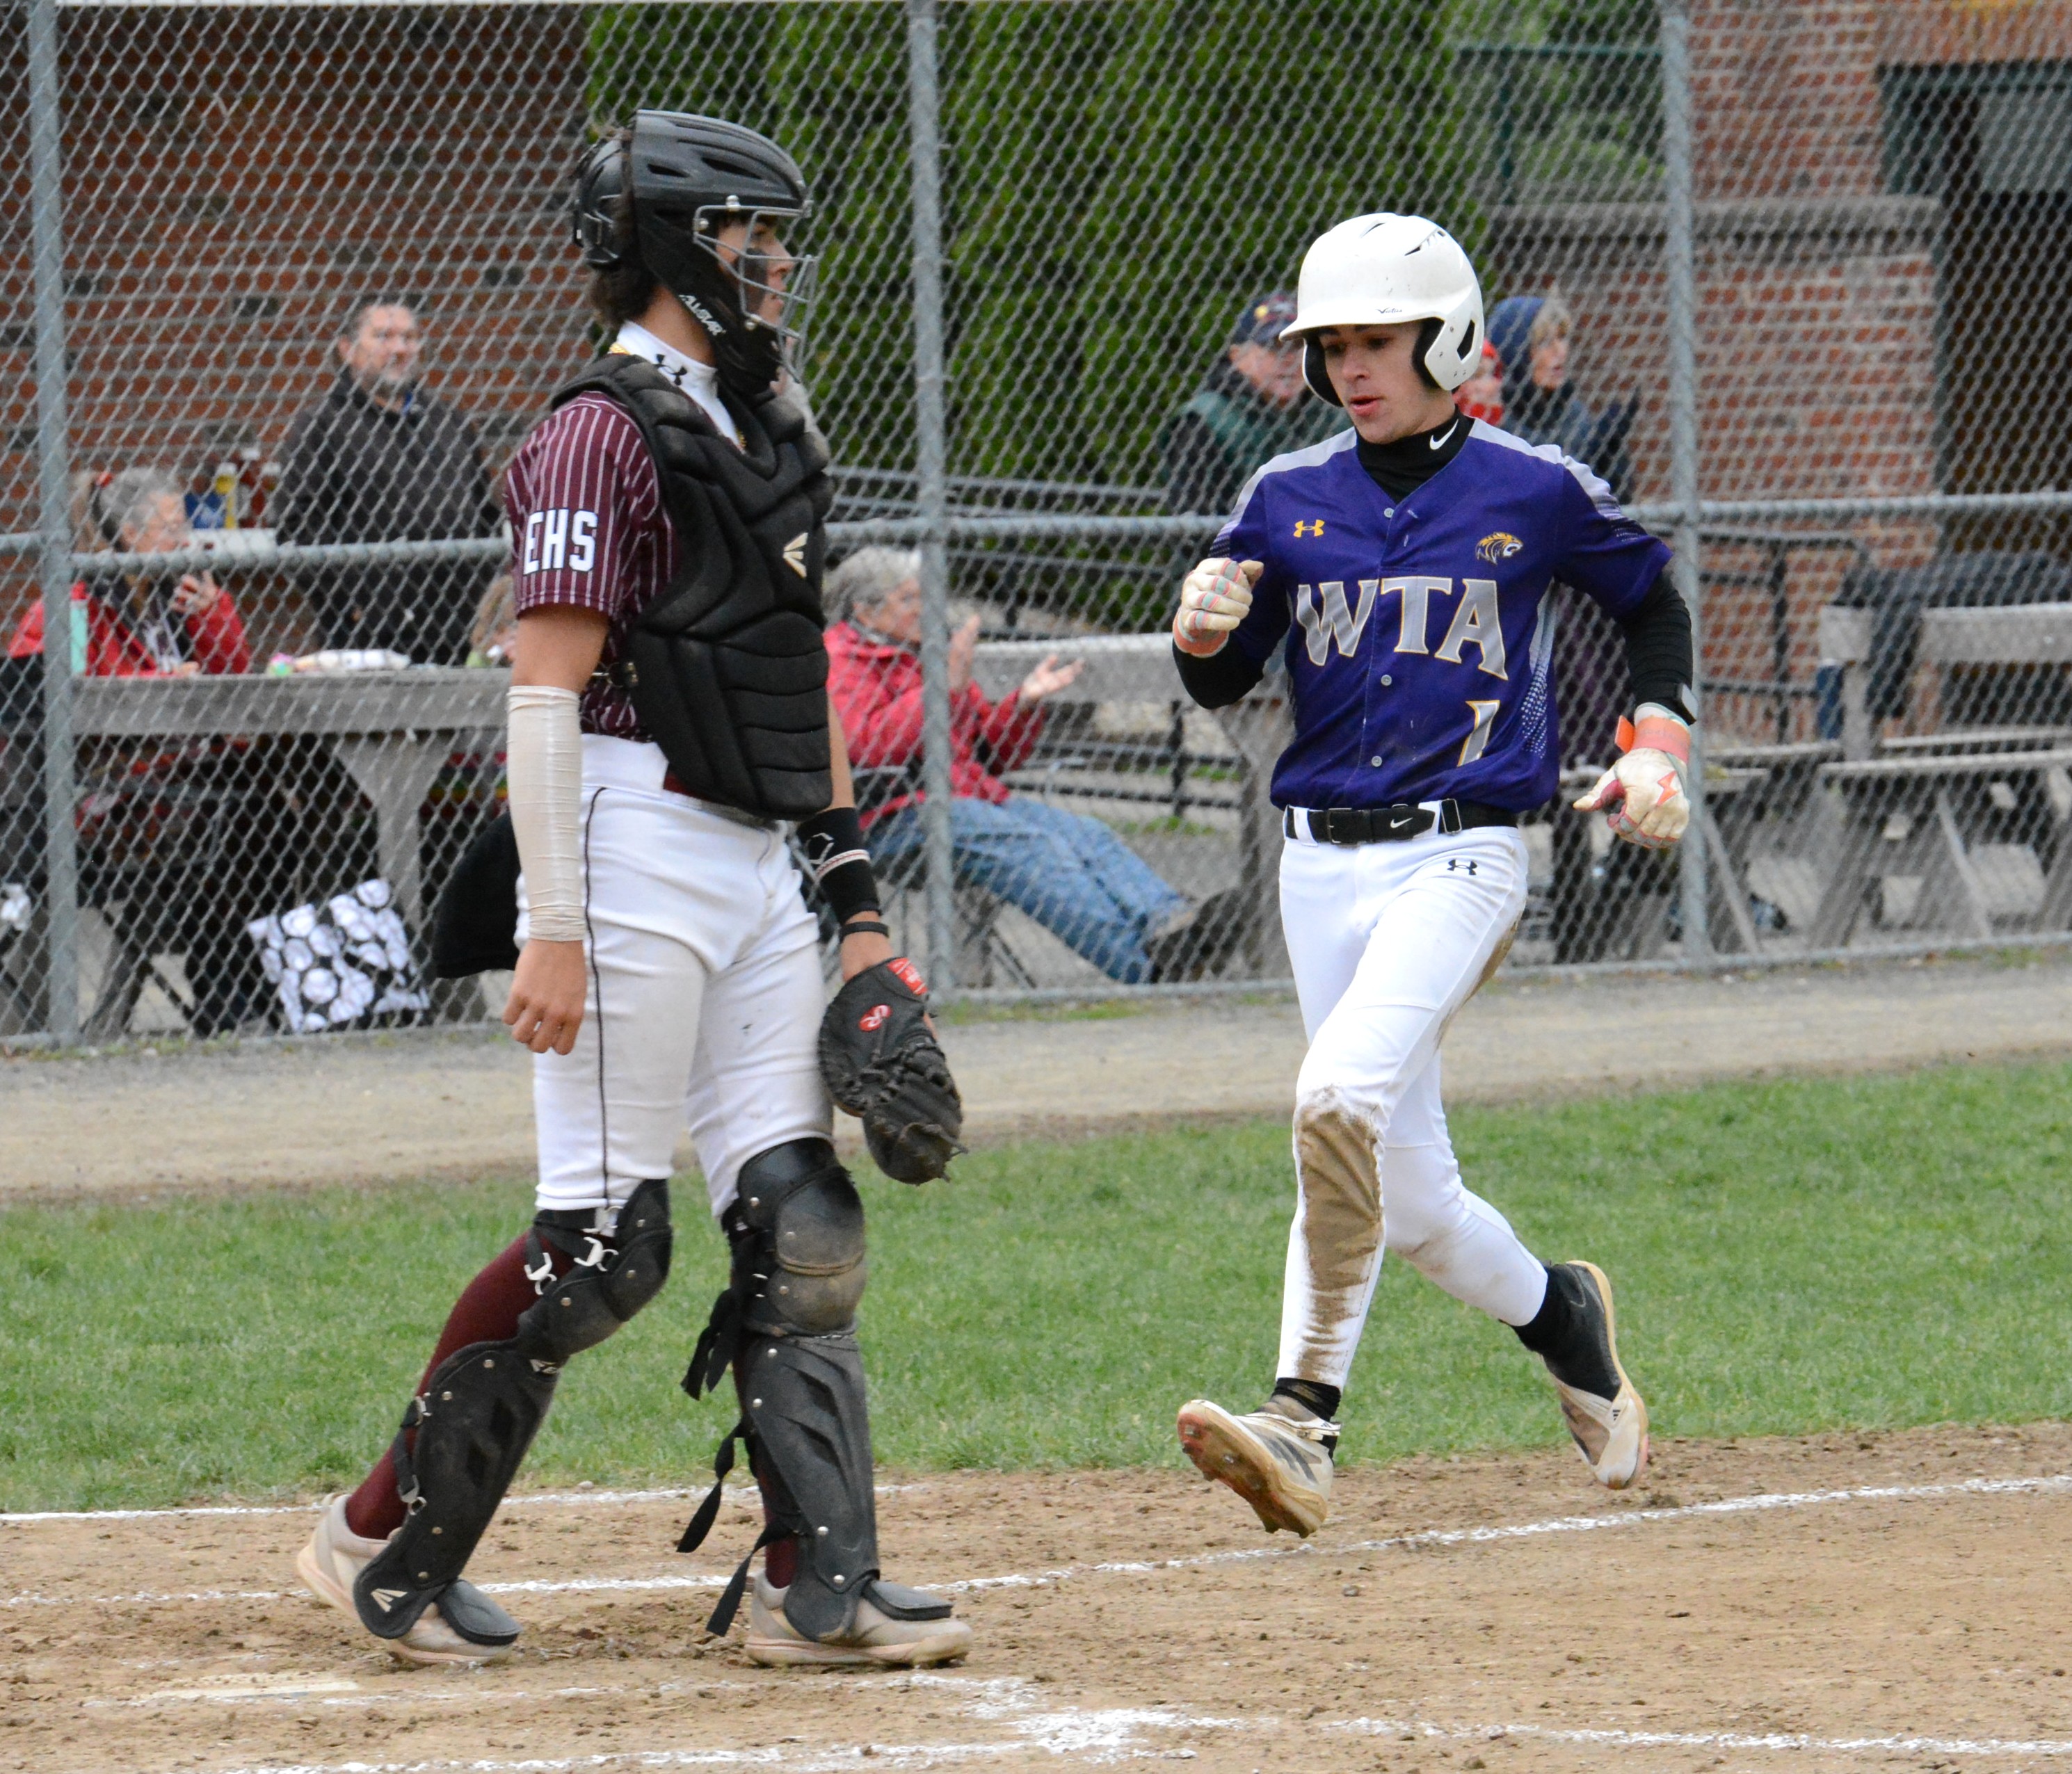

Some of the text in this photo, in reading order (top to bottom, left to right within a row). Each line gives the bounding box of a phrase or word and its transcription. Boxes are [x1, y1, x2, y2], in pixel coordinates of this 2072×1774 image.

[523, 508, 599, 575] EHS
[1296, 575, 1509, 681] WTA
[1456, 699, 1501, 768] 1
